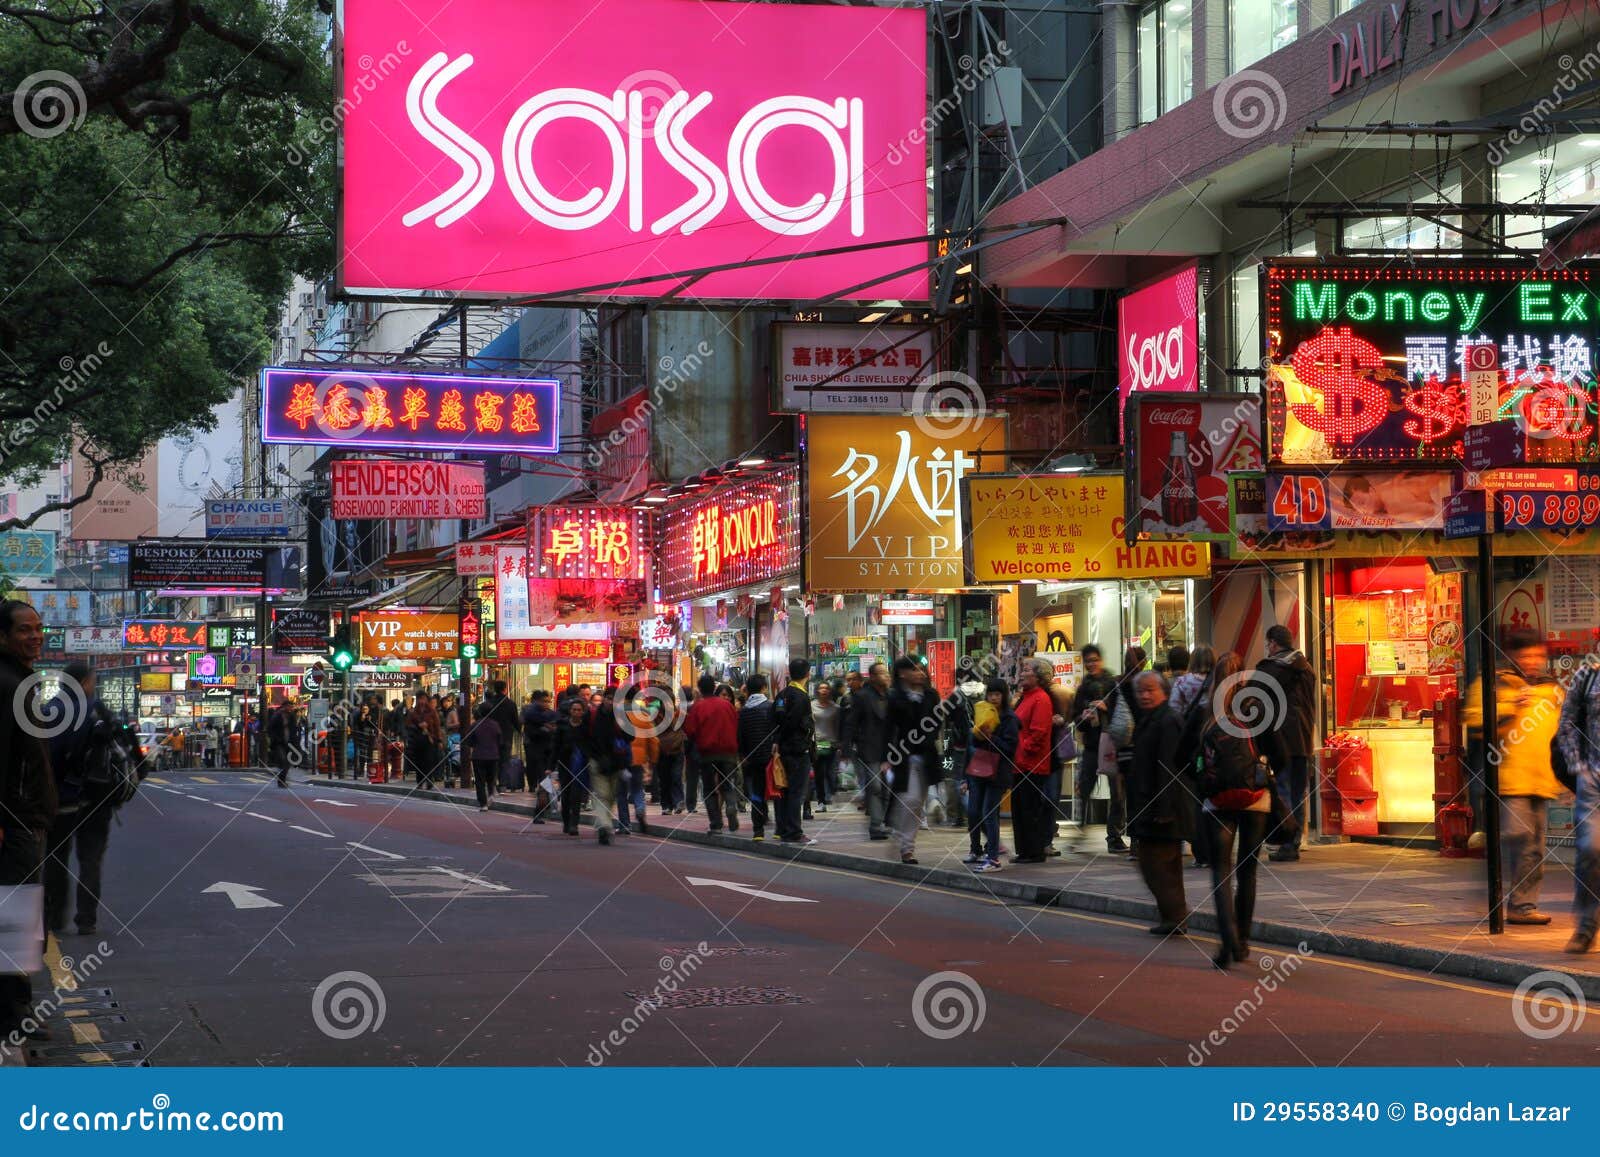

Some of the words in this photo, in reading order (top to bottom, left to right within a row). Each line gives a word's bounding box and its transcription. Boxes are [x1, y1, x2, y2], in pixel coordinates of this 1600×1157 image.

[1329, 1, 1406, 94] DAILY
[1296, 284, 1485, 331] Money
[1520, 284, 1600, 321] Ex
[784, 374, 808, 383] CHIA
[854, 374, 913, 385] JEWELLERY
[827, 395, 847, 404] TEL:
[1476, 374, 1492, 423] 尖沙咀
[332, 464, 450, 496] HENDERSON
[828, 430, 975, 554] 名人站
[1272, 474, 1327, 525] 4D
[210, 502, 283, 514] CHANGE
[333, 499, 386, 516] ROSEWOOD
[391, 499, 440, 515] FURNITURE
[443, 500, 450, 515] &
[455, 499, 485, 514] CHEST
[723, 500, 776, 560] BONJOUR
[1008, 524, 1083, 538] 欢迎您光临
[135, 548, 197, 558] BESPOKE
[206, 548, 264, 559] TAILORS
[872, 536, 950, 559] VIP
[1016, 542, 1076, 555] 歡迎光臨
[1116, 545, 1198, 569] HIANG
[859, 561, 959, 576] STATION
[991, 559, 1072, 575] Welcome
[1084, 557, 1101, 573] to
[364, 621, 401, 637] VIP
[404, 629, 425, 638] watch
[426, 629, 434, 638] &
